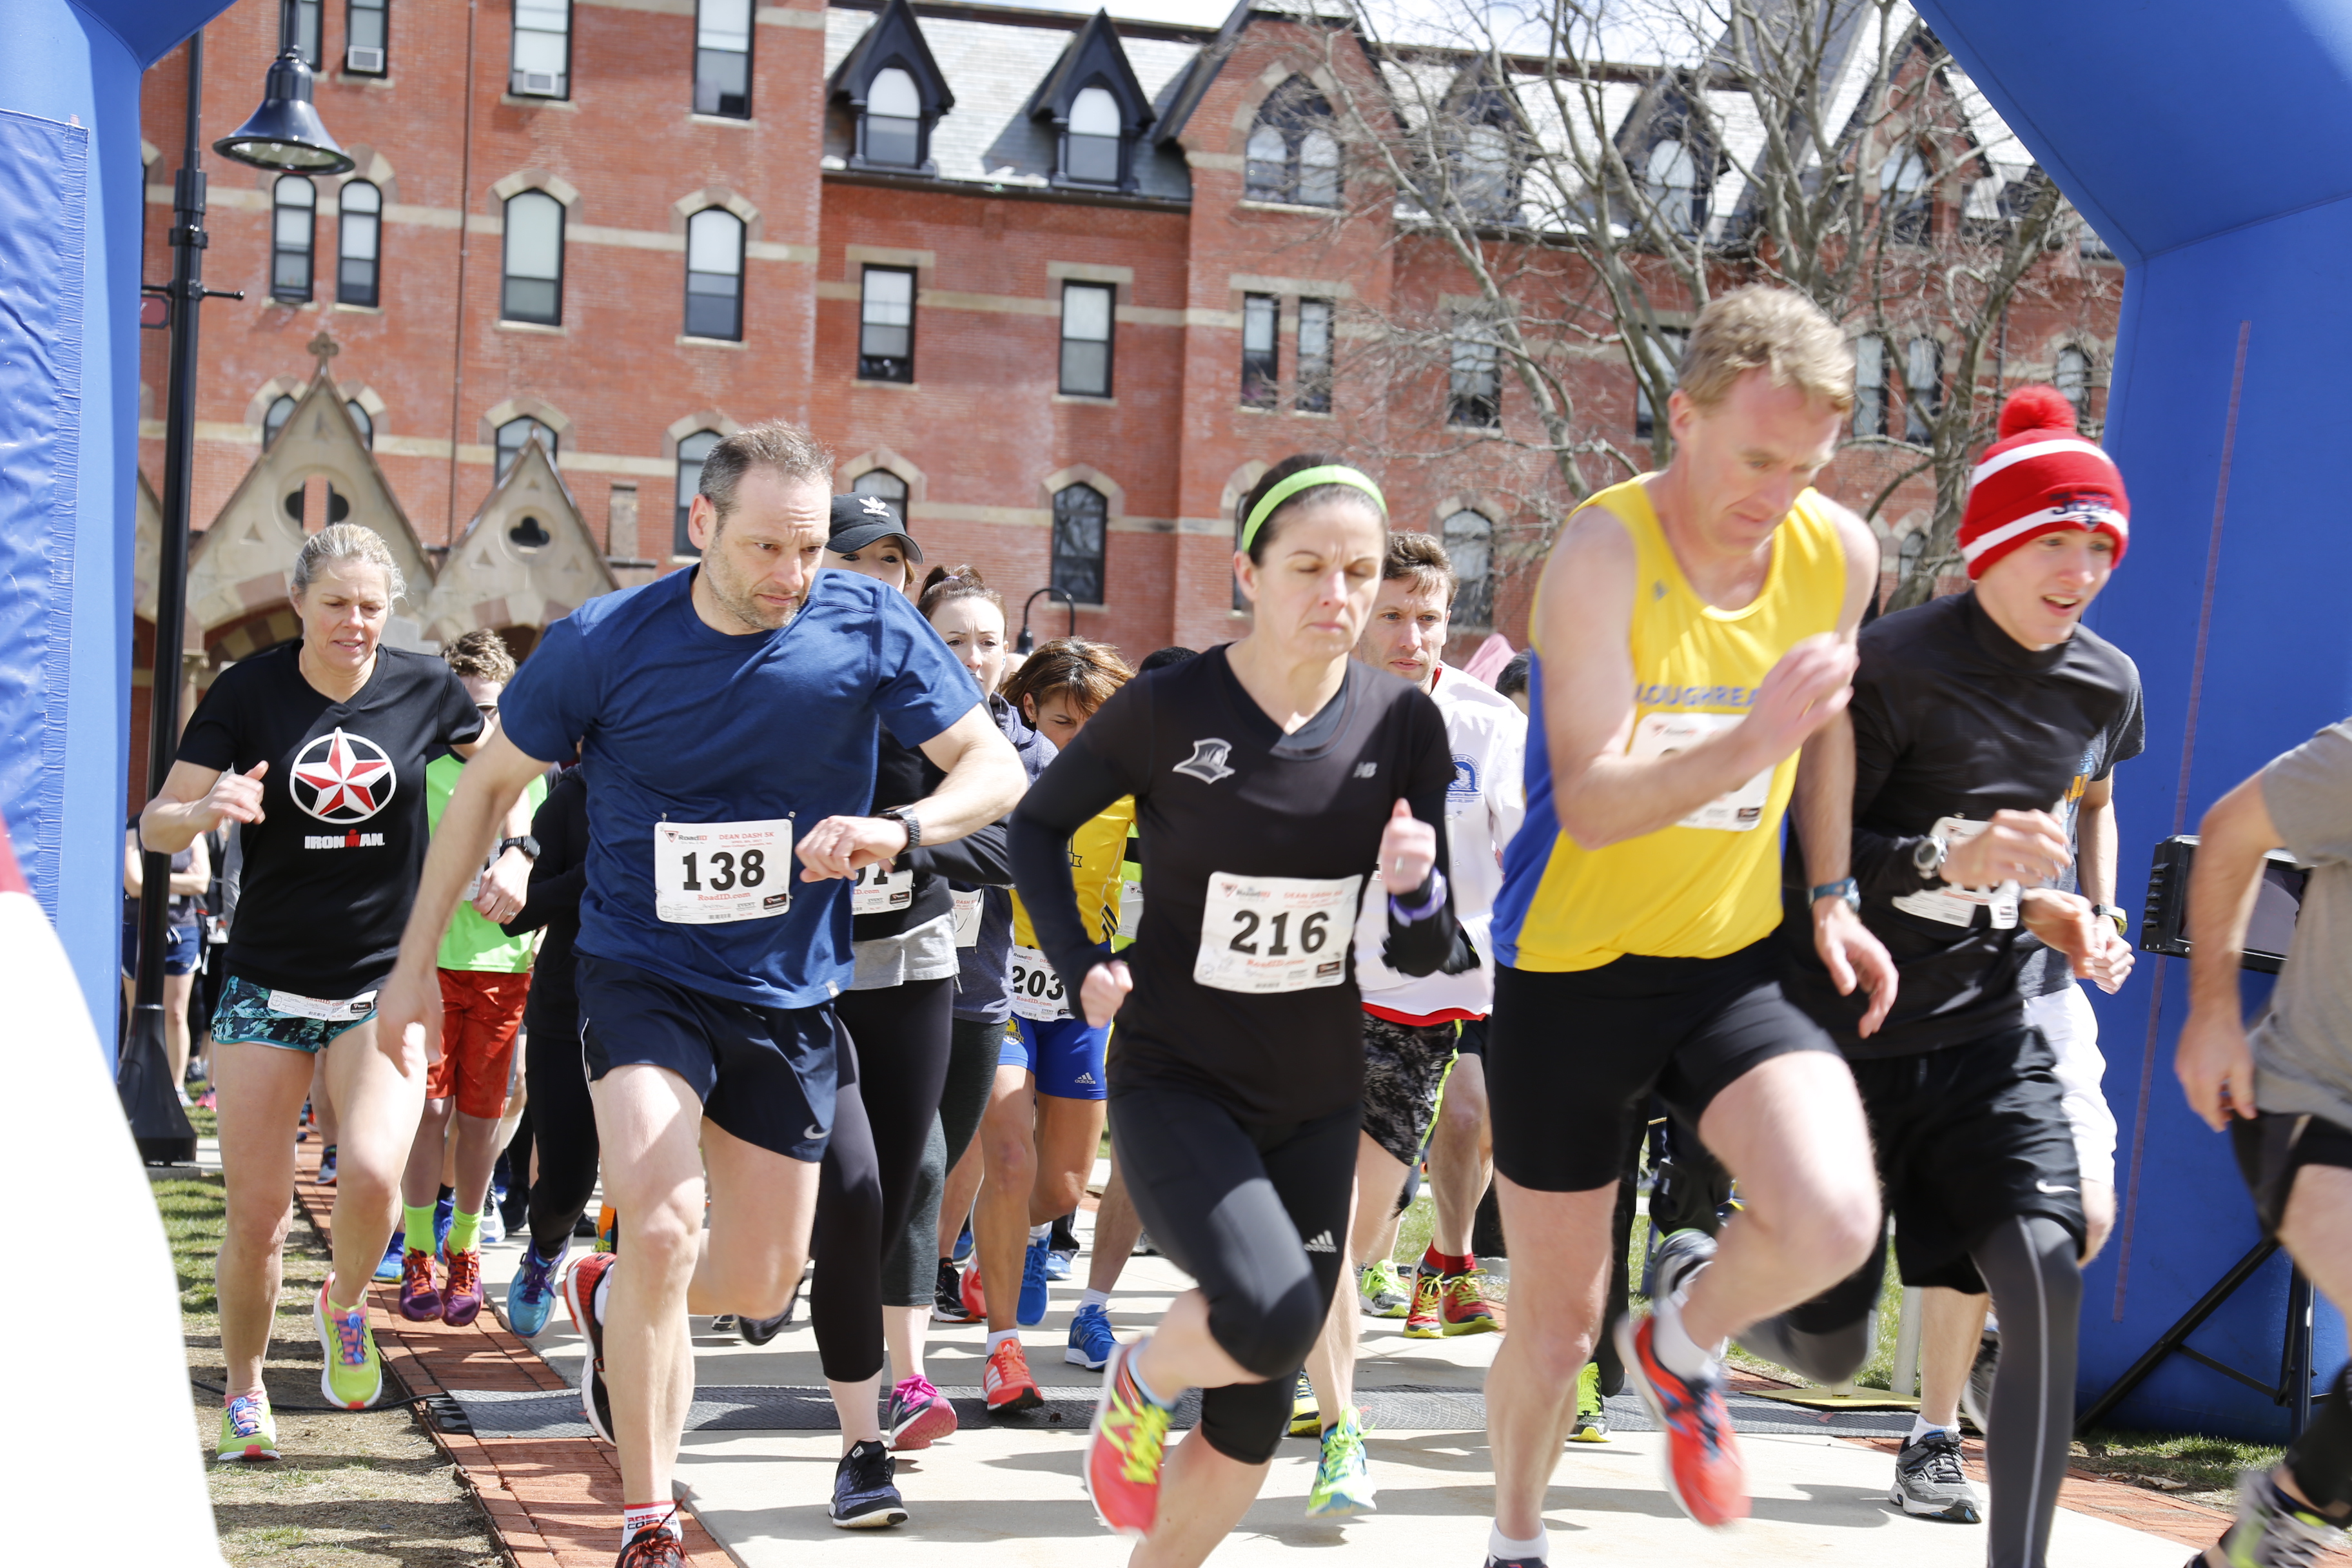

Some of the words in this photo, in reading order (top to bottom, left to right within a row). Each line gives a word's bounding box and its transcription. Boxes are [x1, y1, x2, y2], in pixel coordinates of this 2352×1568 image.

[862, 507, 890, 517] adidas
[682, 849, 765, 891] 138
[697, 892, 751, 901] RoadID.com
[1230, 910, 1329, 956] 216
[1014, 952, 1033, 961] RoadID
[1012, 965, 1064, 1001] 203
[1016, 995, 1052, 1006] RoadID.com
